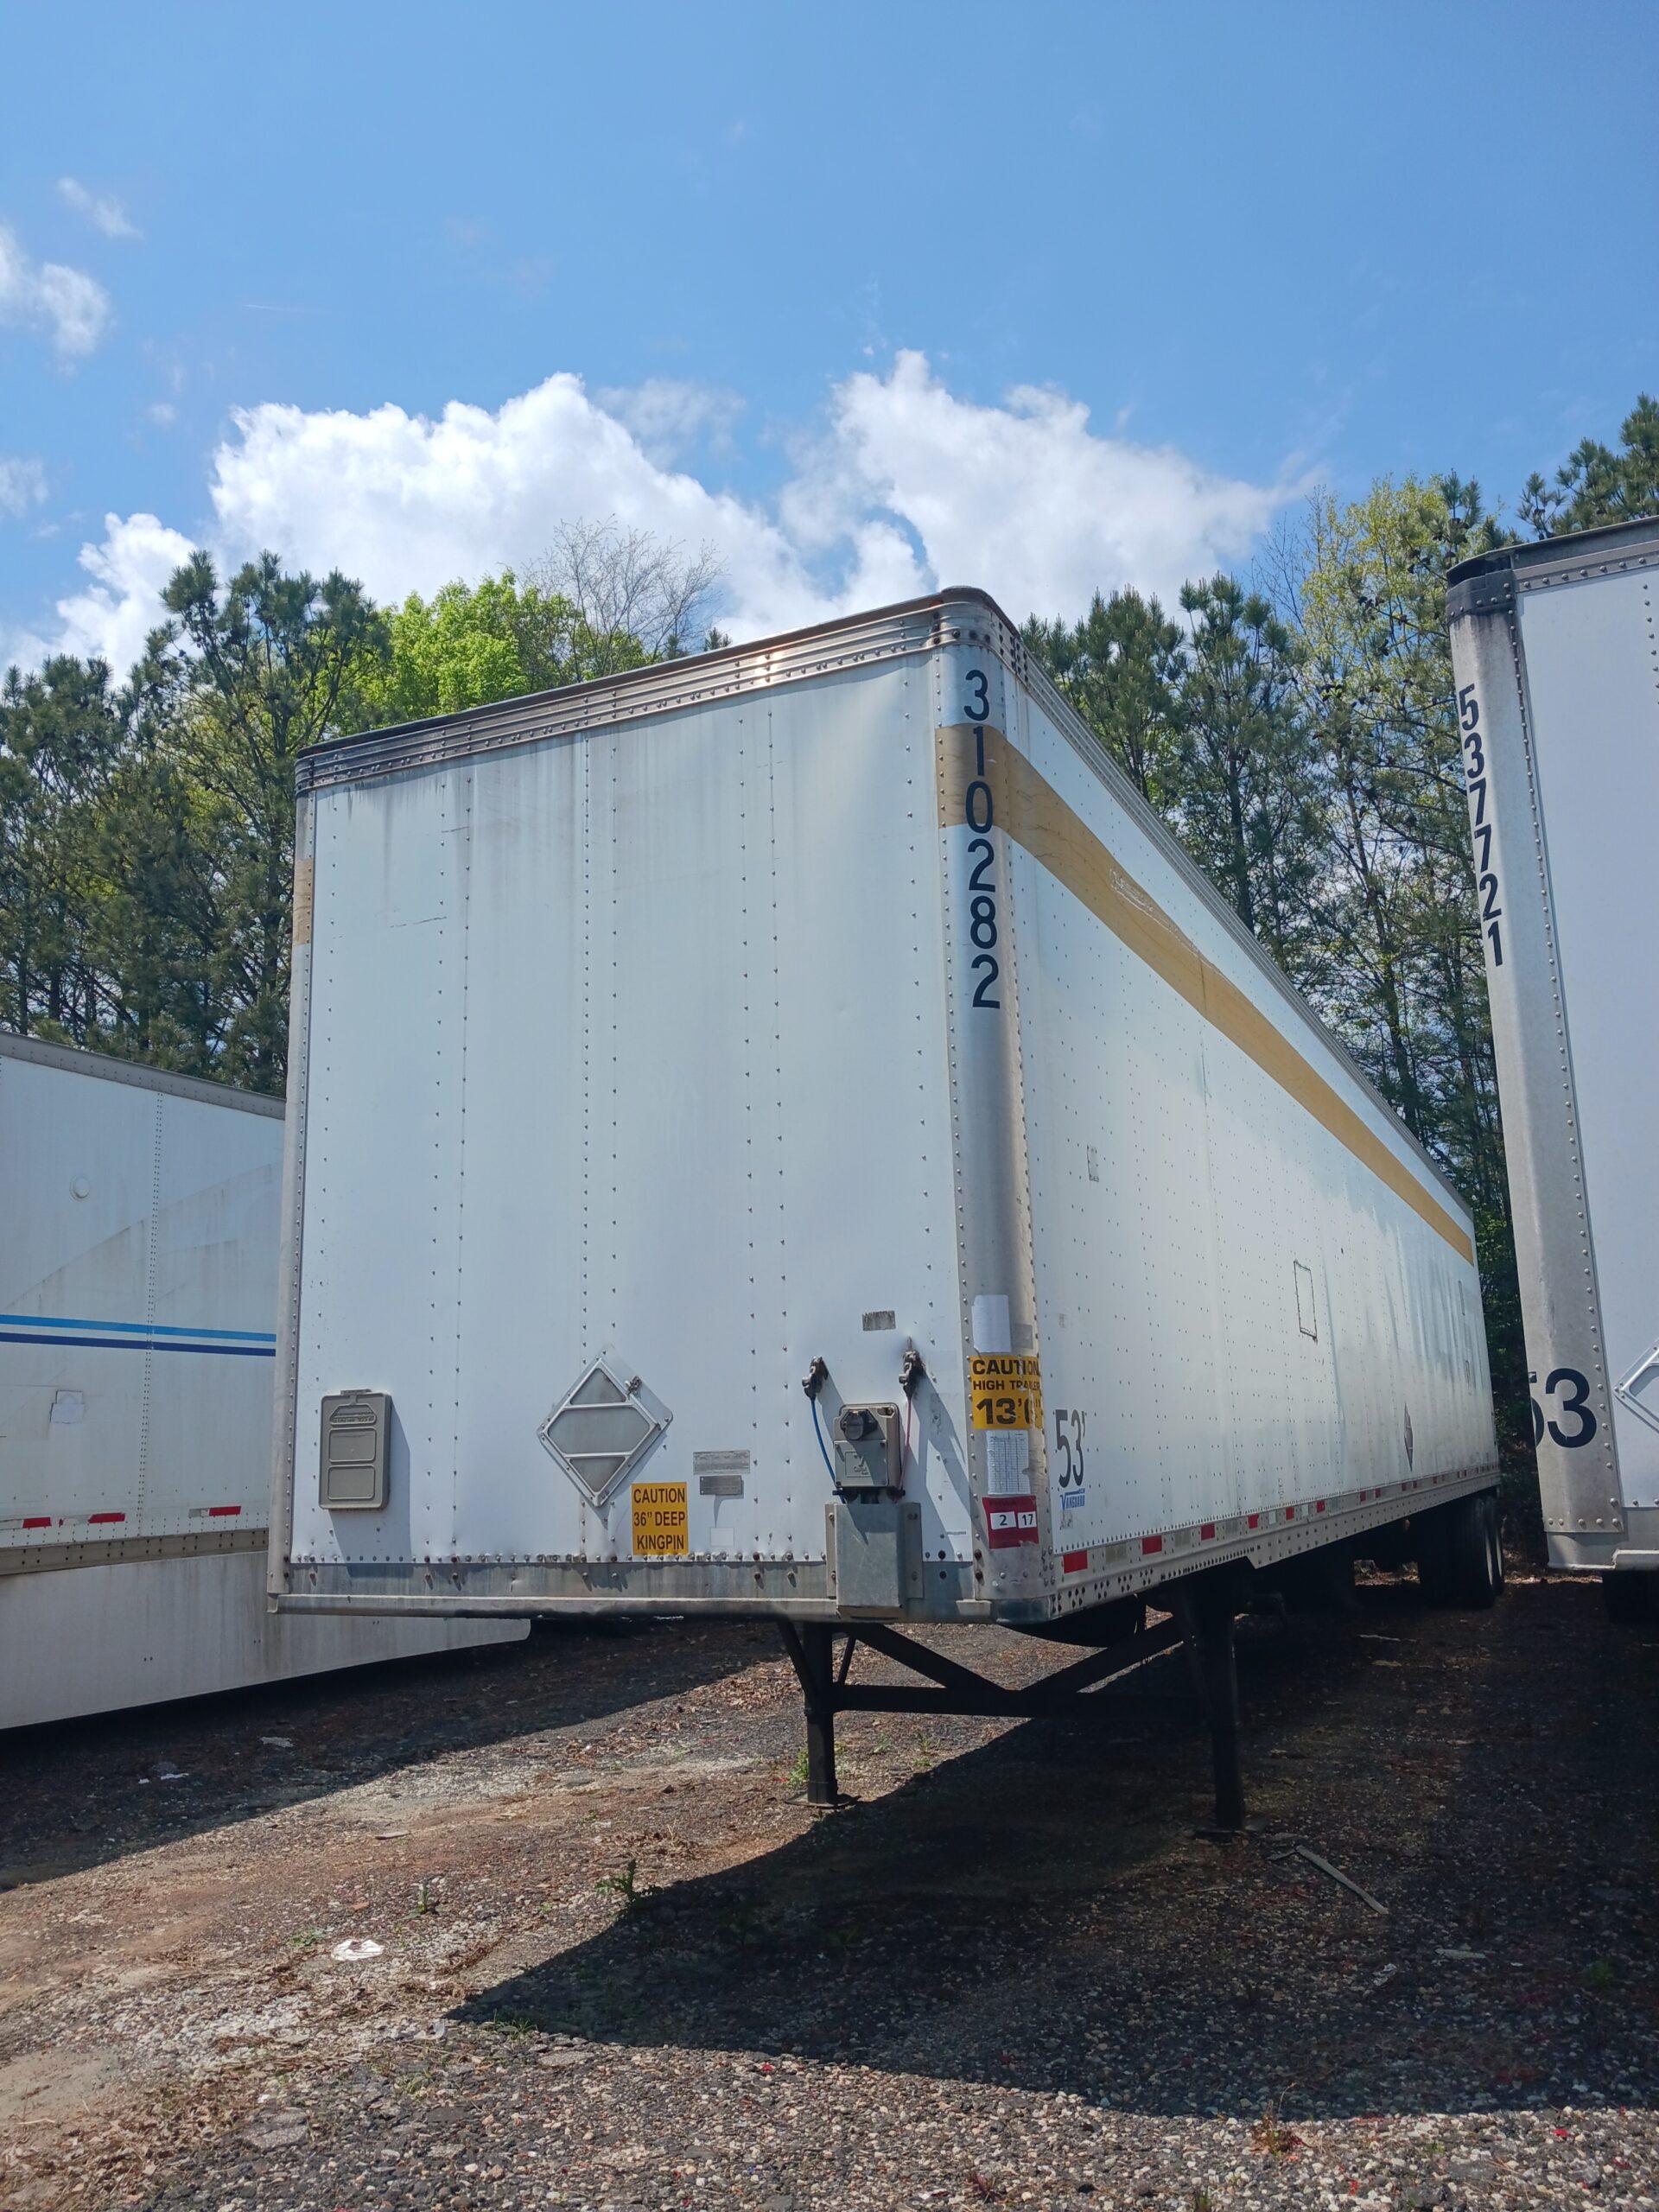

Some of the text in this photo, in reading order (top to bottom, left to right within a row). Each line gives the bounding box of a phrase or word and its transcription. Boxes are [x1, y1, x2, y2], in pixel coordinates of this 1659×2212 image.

[1458, 683, 1503, 967] 537721
[963, 669, 1001, 1009] 310282
[972, 1359, 1040, 1376] CAUTION
[973, 1380, 1005, 1390] HIGH
[1055, 1408, 1086, 1488] 53'
[633, 1487, 685, 1503] CAUTION
[654, 1511, 685, 1527] DEEP
[999, 1513, 1033, 1526] 2 17
[636, 1534, 684, 1550] KINGPIN
